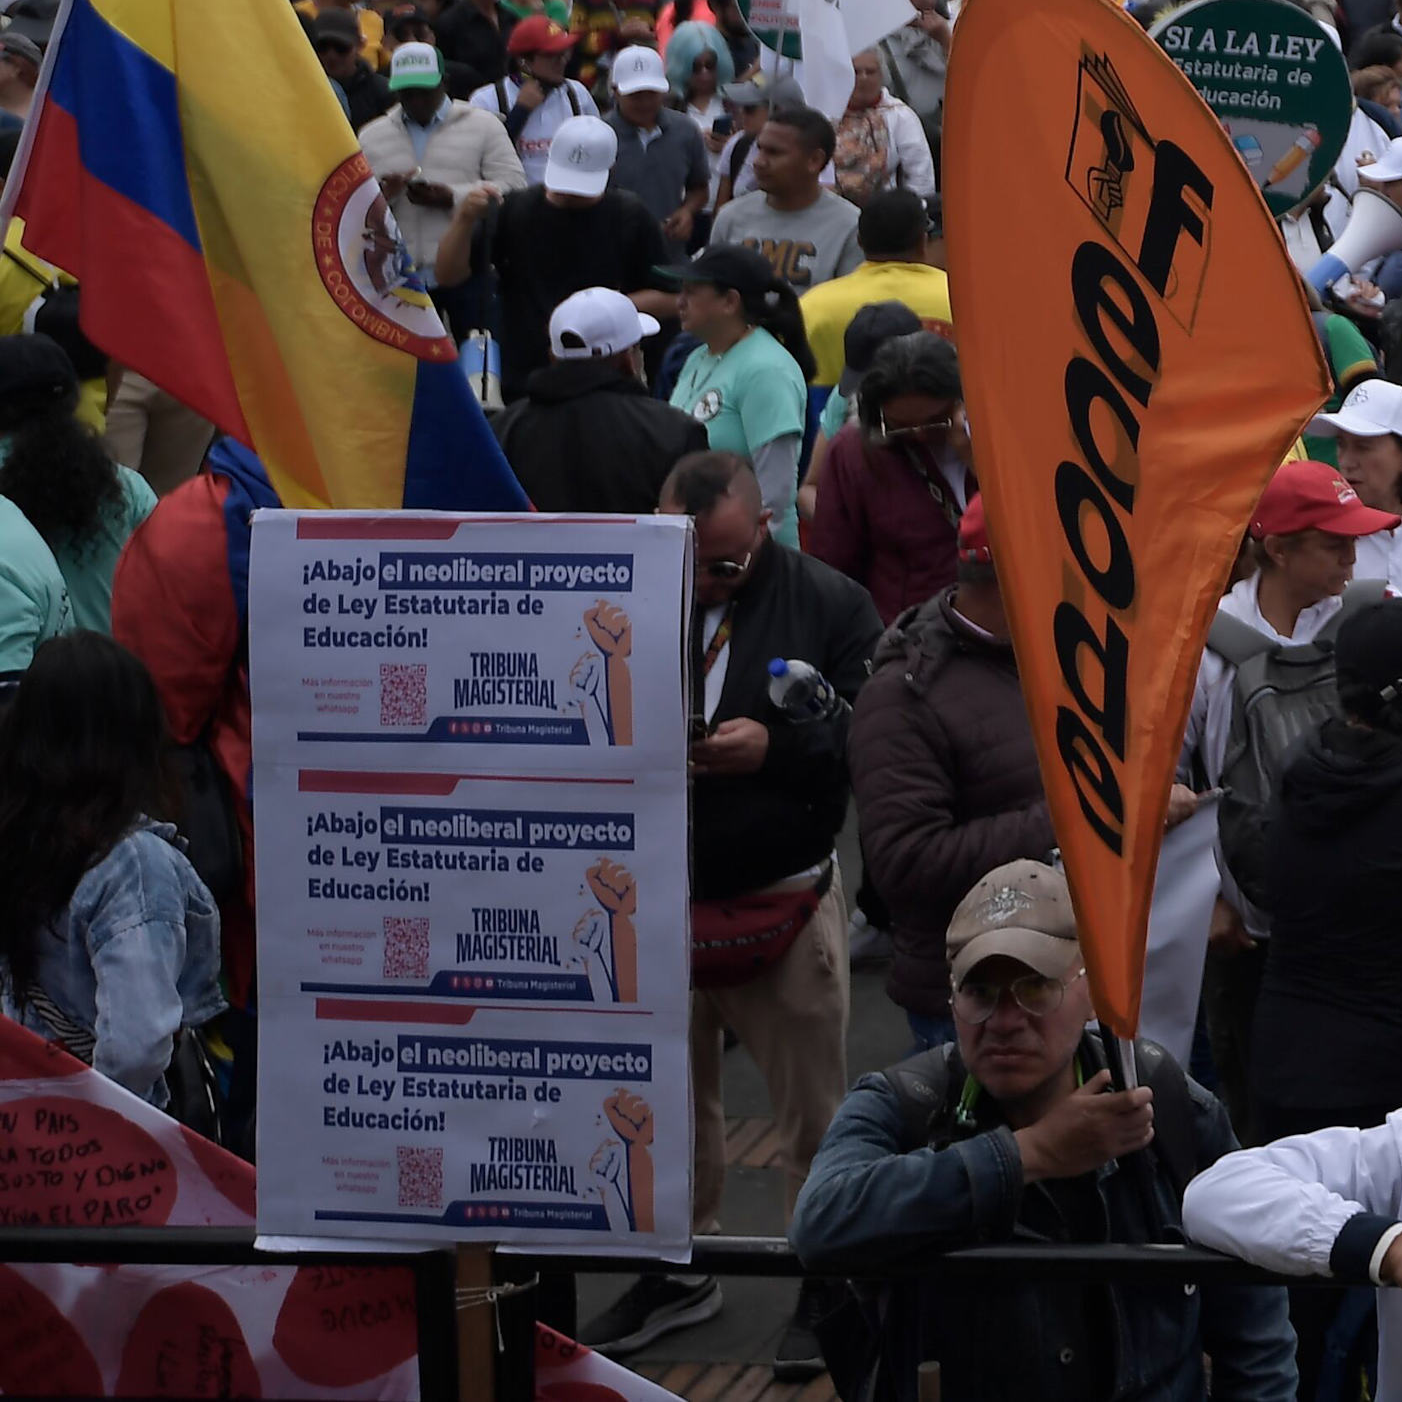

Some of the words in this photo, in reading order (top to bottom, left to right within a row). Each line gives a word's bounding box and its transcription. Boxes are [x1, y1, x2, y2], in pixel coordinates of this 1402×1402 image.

[1165, 25, 1194, 50] SI
[1198, 28, 1218, 53] A
[1224, 30, 1261, 57] LA
[1267, 34, 1325, 62] LEY
[1173, 58, 1278, 83] Estatutaria
[1287, 67, 1313, 86] de
[1198, 86, 1282, 110] ducación
[303, 559, 376, 584] ¡Abajo
[382, 560, 402, 583] el
[409, 557, 523, 584] neoliberal
[530, 562, 630, 587] proyecto
[303, 595, 331, 615] de
[338, 594, 377, 619] Ley
[384, 592, 510, 615] Estatutaria
[517, 594, 544, 616] de
[303, 624, 428, 648] Educación!
[470, 652, 539, 678] TRIBUNA
[454, 678, 558, 711] MAGISTERIAL
[495, 723, 526, 734] Tribuna
[528, 724, 572, 735] Magisterial
[307, 812, 377, 836] ¡Abajo
[383, 814, 404, 836] el
[410, 816, 523, 840] neoliberal
[529, 822, 631, 846] proyecto
[308, 846, 335, 866] de
[342, 847, 379, 871] Ley
[387, 848, 510, 872] Estatutaria
[516, 853, 544, 873] de
[308, 878, 430, 902] Educación!
[472, 907, 539, 934] TRIBUNA
[456, 933, 561, 966] MAGISTERIAL
[496, 979, 527, 989] Tribuna
[529, 980, 576, 991] Magisterial
[323, 1040, 395, 1066] ¡Abajo
[400, 1043, 421, 1064] el
[428, 1043, 539, 1069] neoliberal
[547, 1050, 648, 1076] proyecto
[323, 1074, 350, 1095] de
[358, 1075, 396, 1100] Ley
[402, 1076, 527, 1101] Estatutaria
[534, 1081, 561, 1103] de
[323, 1107, 446, 1131] Educación!
[27, 1138, 102, 1165] TODOS
[488, 1137, 557, 1164] TRIBUNA
[470, 1163, 578, 1196] MAGISTERIAL
[513, 1208, 544, 1218] Tribuna
[546, 1209, 593, 1220] Magisterial
